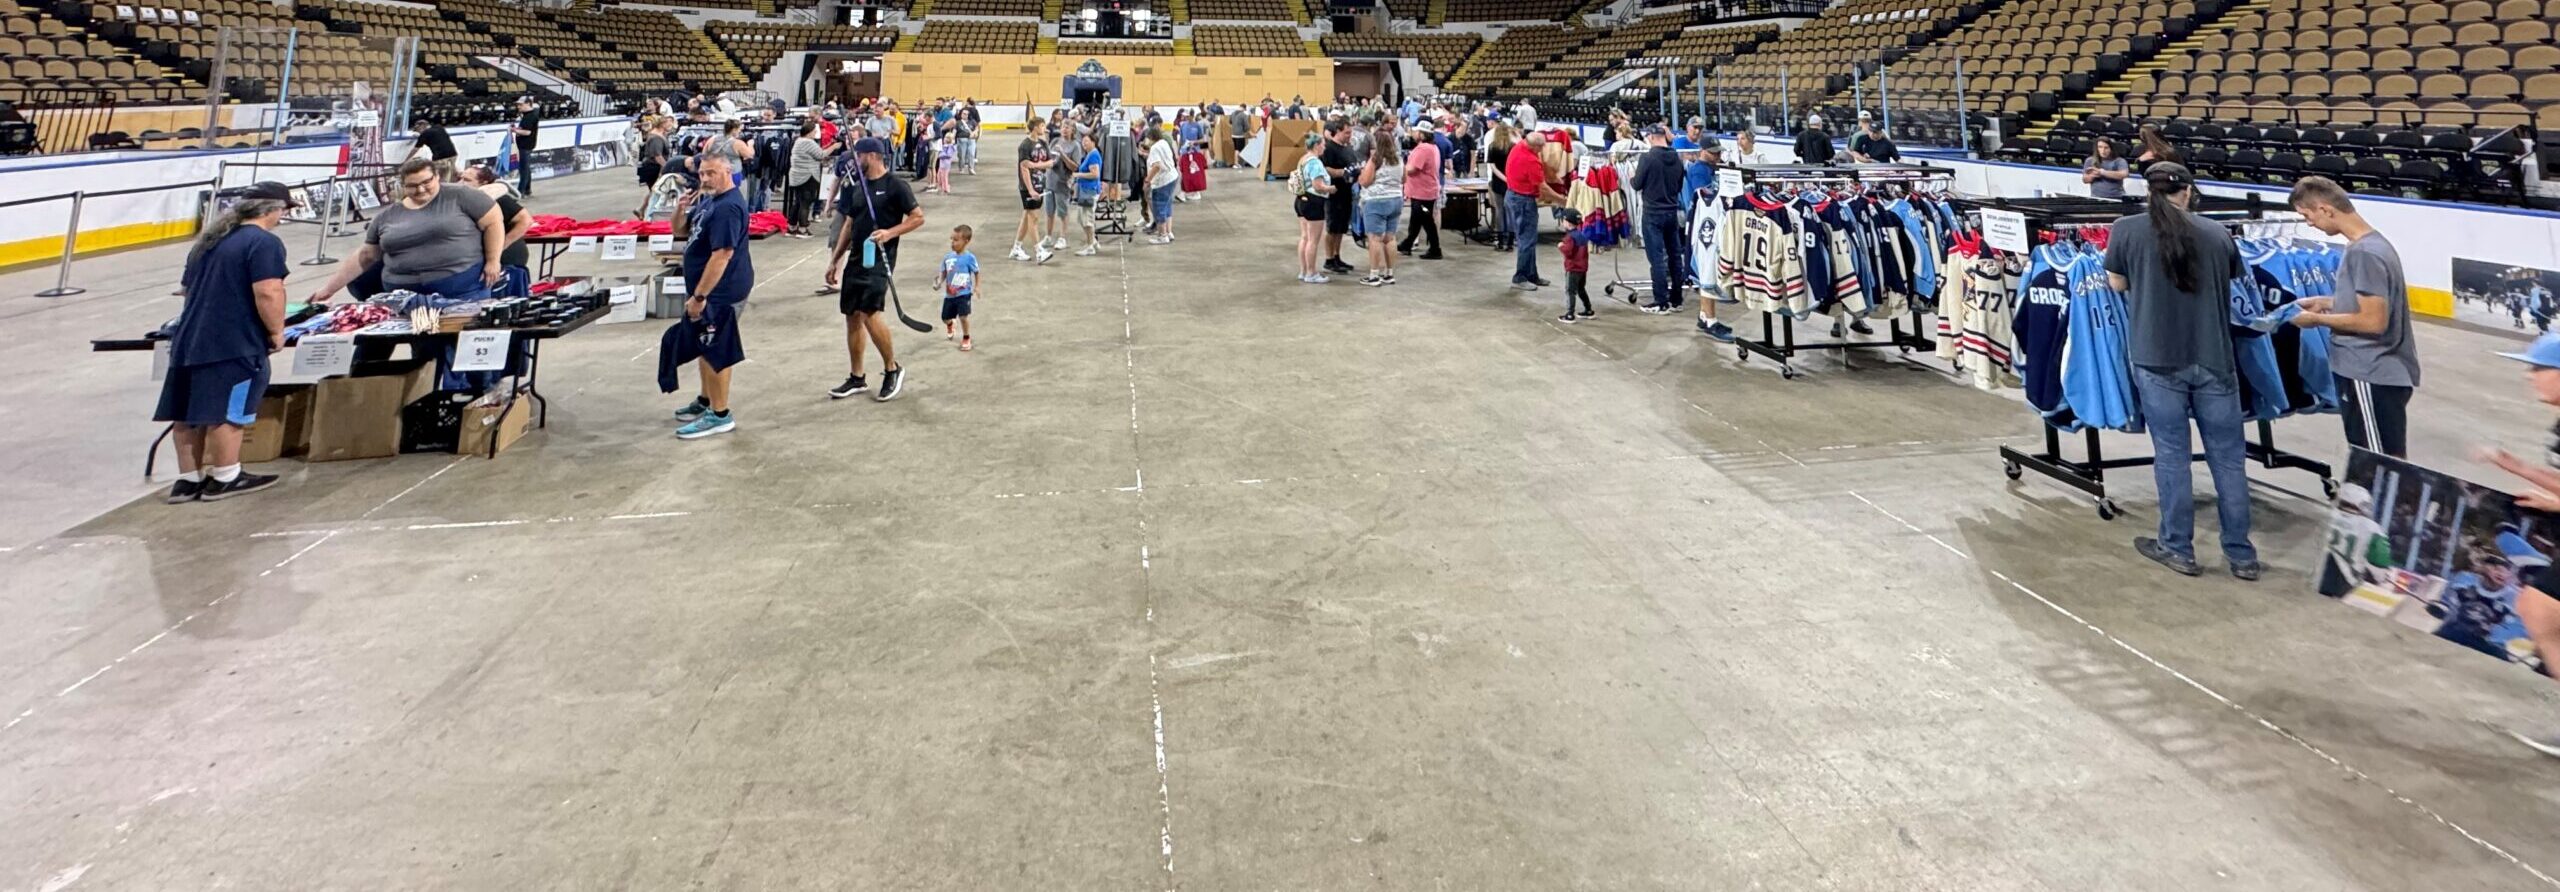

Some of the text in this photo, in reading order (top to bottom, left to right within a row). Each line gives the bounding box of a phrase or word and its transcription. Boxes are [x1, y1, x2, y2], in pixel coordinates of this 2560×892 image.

[1743, 232, 1768, 273] 19
[1977, 290, 2003, 313] 77
[2092, 305, 2117, 329] 12
[475, 347, 488, 356] $3
